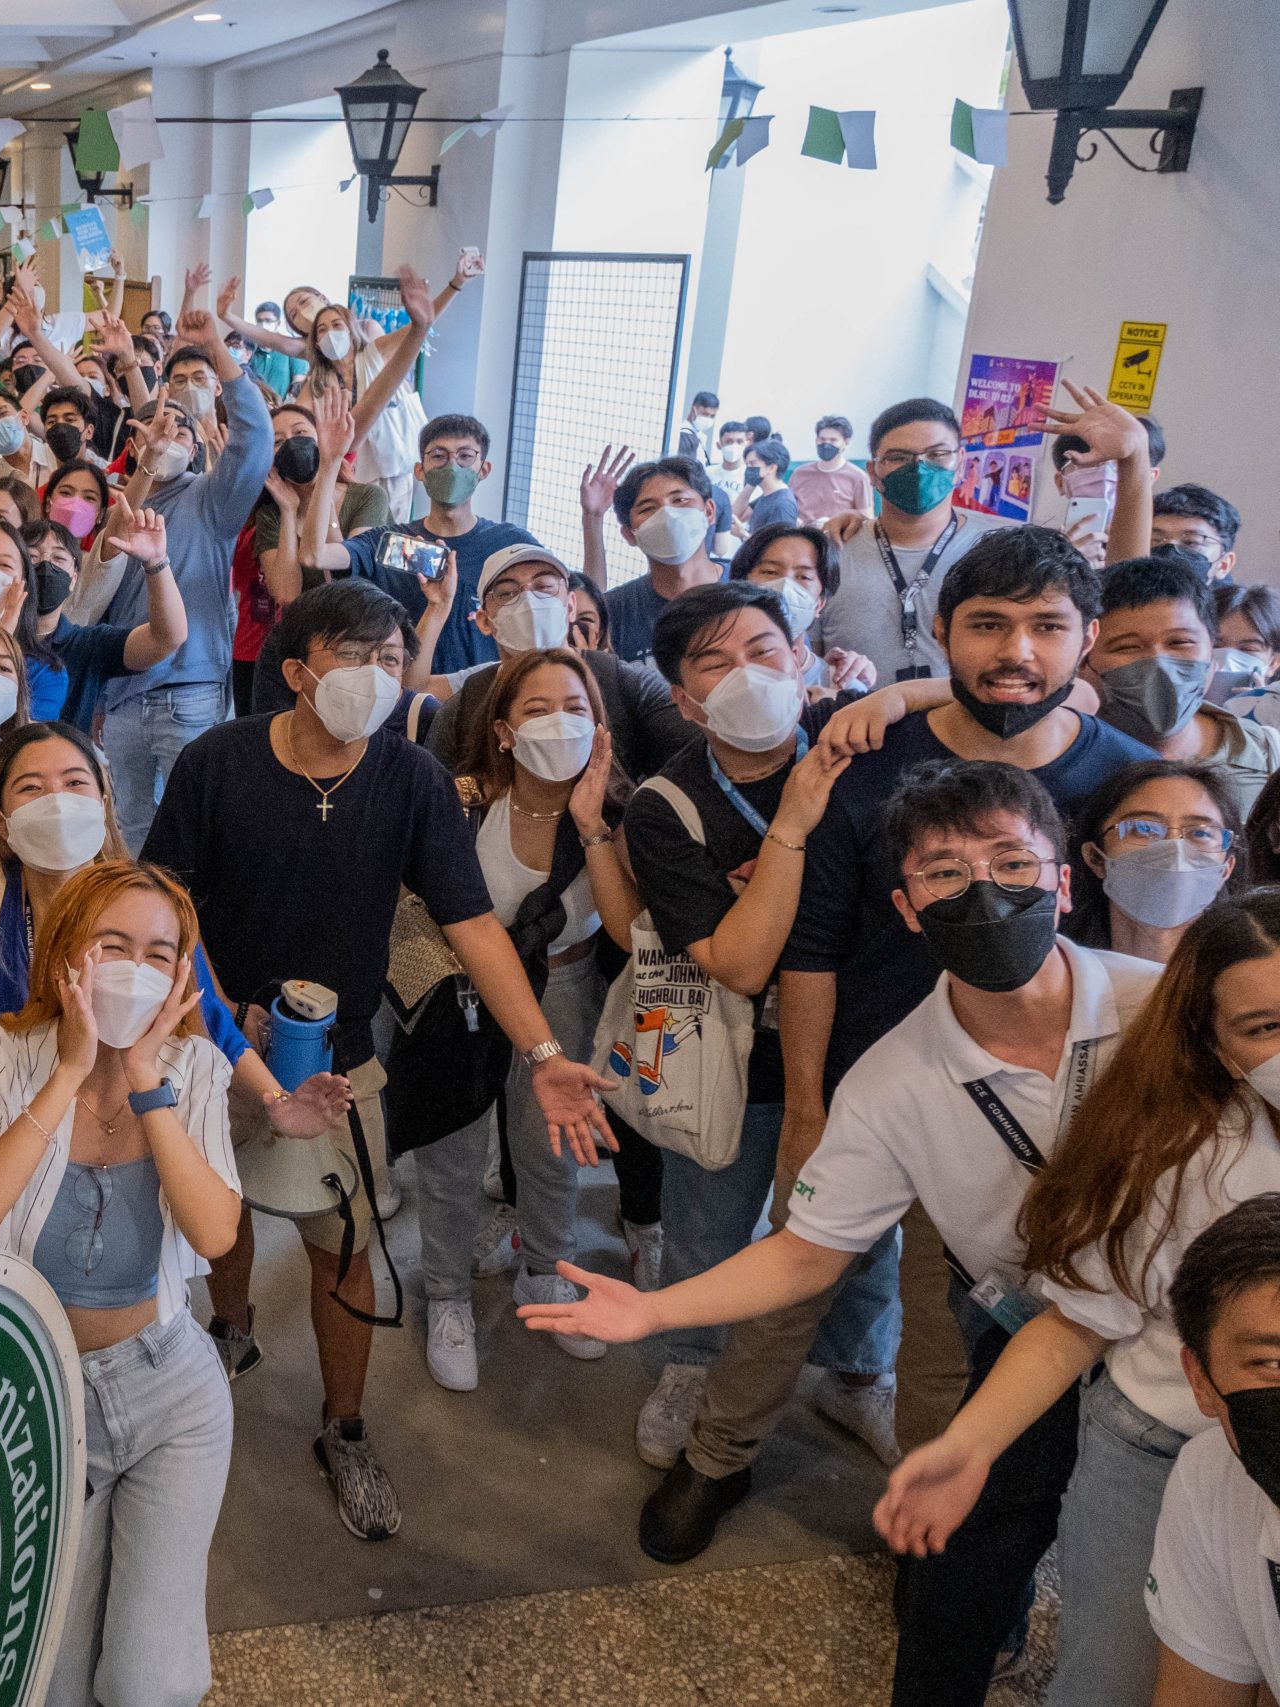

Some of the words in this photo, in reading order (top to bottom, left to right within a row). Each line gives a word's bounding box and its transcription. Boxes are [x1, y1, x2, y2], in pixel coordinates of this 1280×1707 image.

[1127, 328, 1159, 338] NOTICE
[970, 378, 1008, 391] WELCOME
[1010, 383, 1021, 393] TO
[1119, 381, 1136, 390] CCTV
[1110, 391, 1149, 402] OPERATION
[26, 915, 32, 925] LA
[26, 926, 35, 946] SALLE
[636, 971, 647, 980] at
[648, 970, 665, 980] the
[638, 988, 685, 1005] HIGHBALL
[1073, 1040, 1089, 1101] AMBASSA
[971, 1081, 988, 1098] ICE
[988, 1102, 1033, 1157] COMMUNION
[795, 1180, 816, 1202] art
